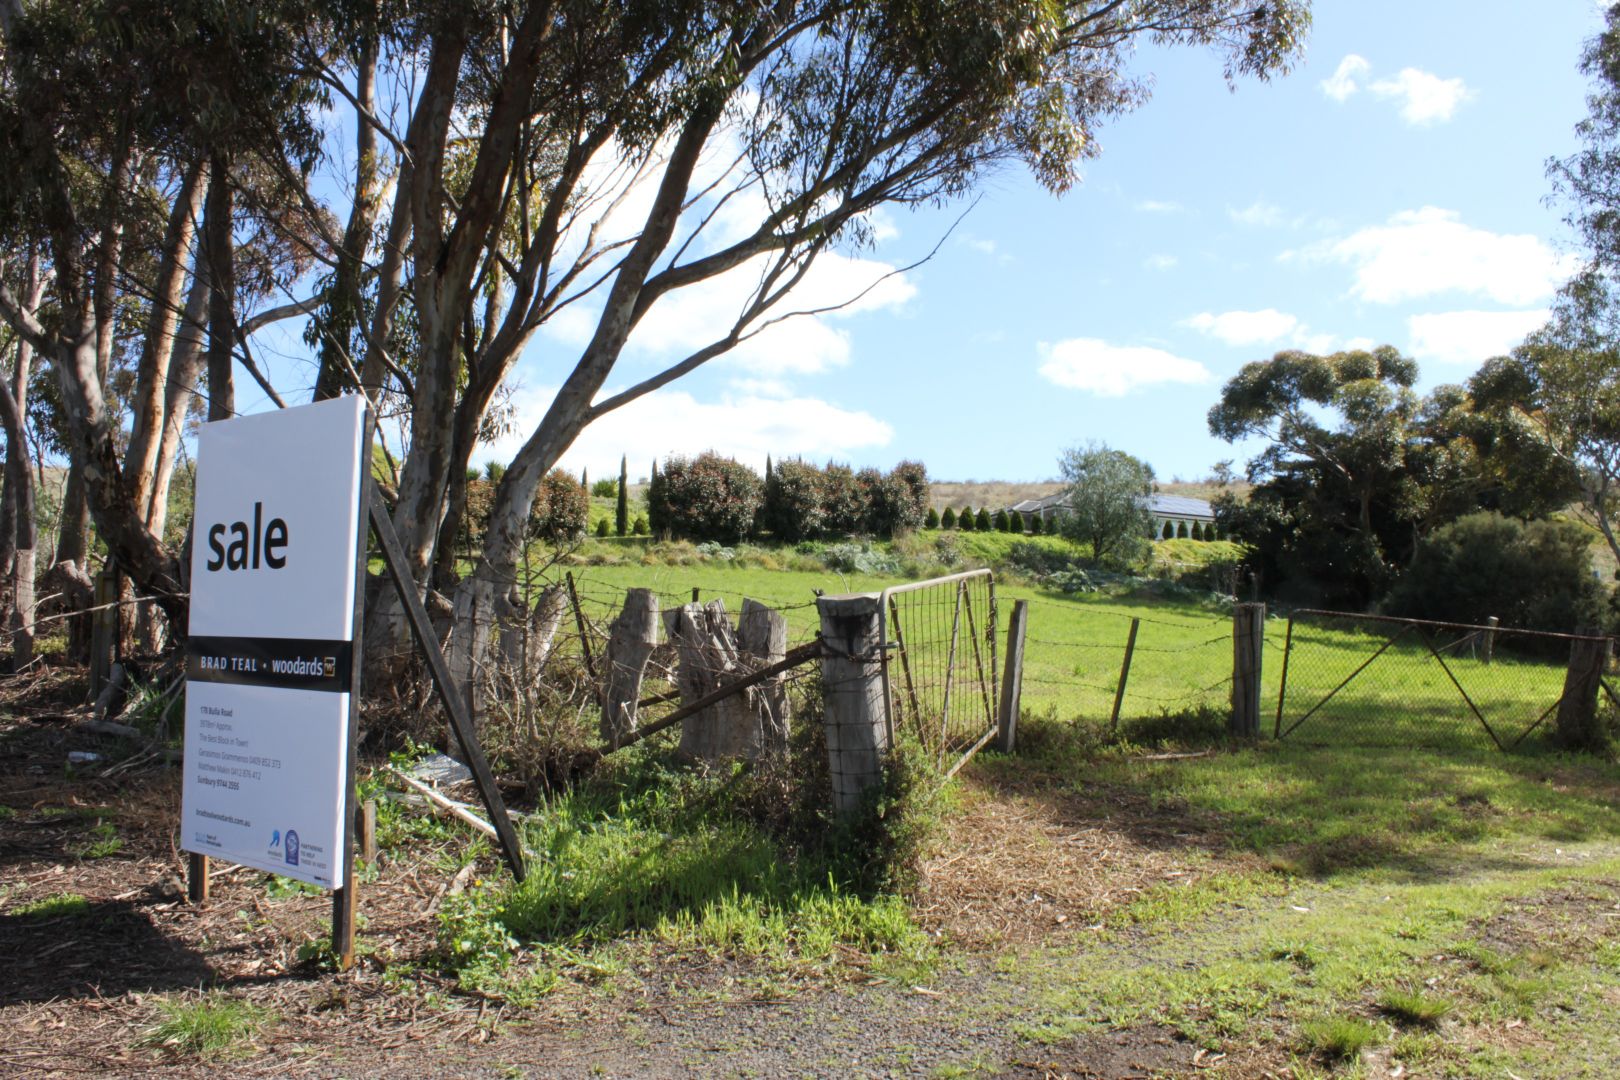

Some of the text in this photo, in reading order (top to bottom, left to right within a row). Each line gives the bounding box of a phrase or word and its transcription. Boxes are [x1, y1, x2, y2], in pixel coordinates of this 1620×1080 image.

[207, 502, 288, 572] sale
[201, 656, 227, 670] BRAD
[231, 657, 257, 672] TEAL
[272, 656, 323, 676] woodards
[221, 708, 233, 717] Road
[208, 734, 217, 743] Best
[217, 735, 229, 744] Block
[197, 775, 216, 789] Sunbury
